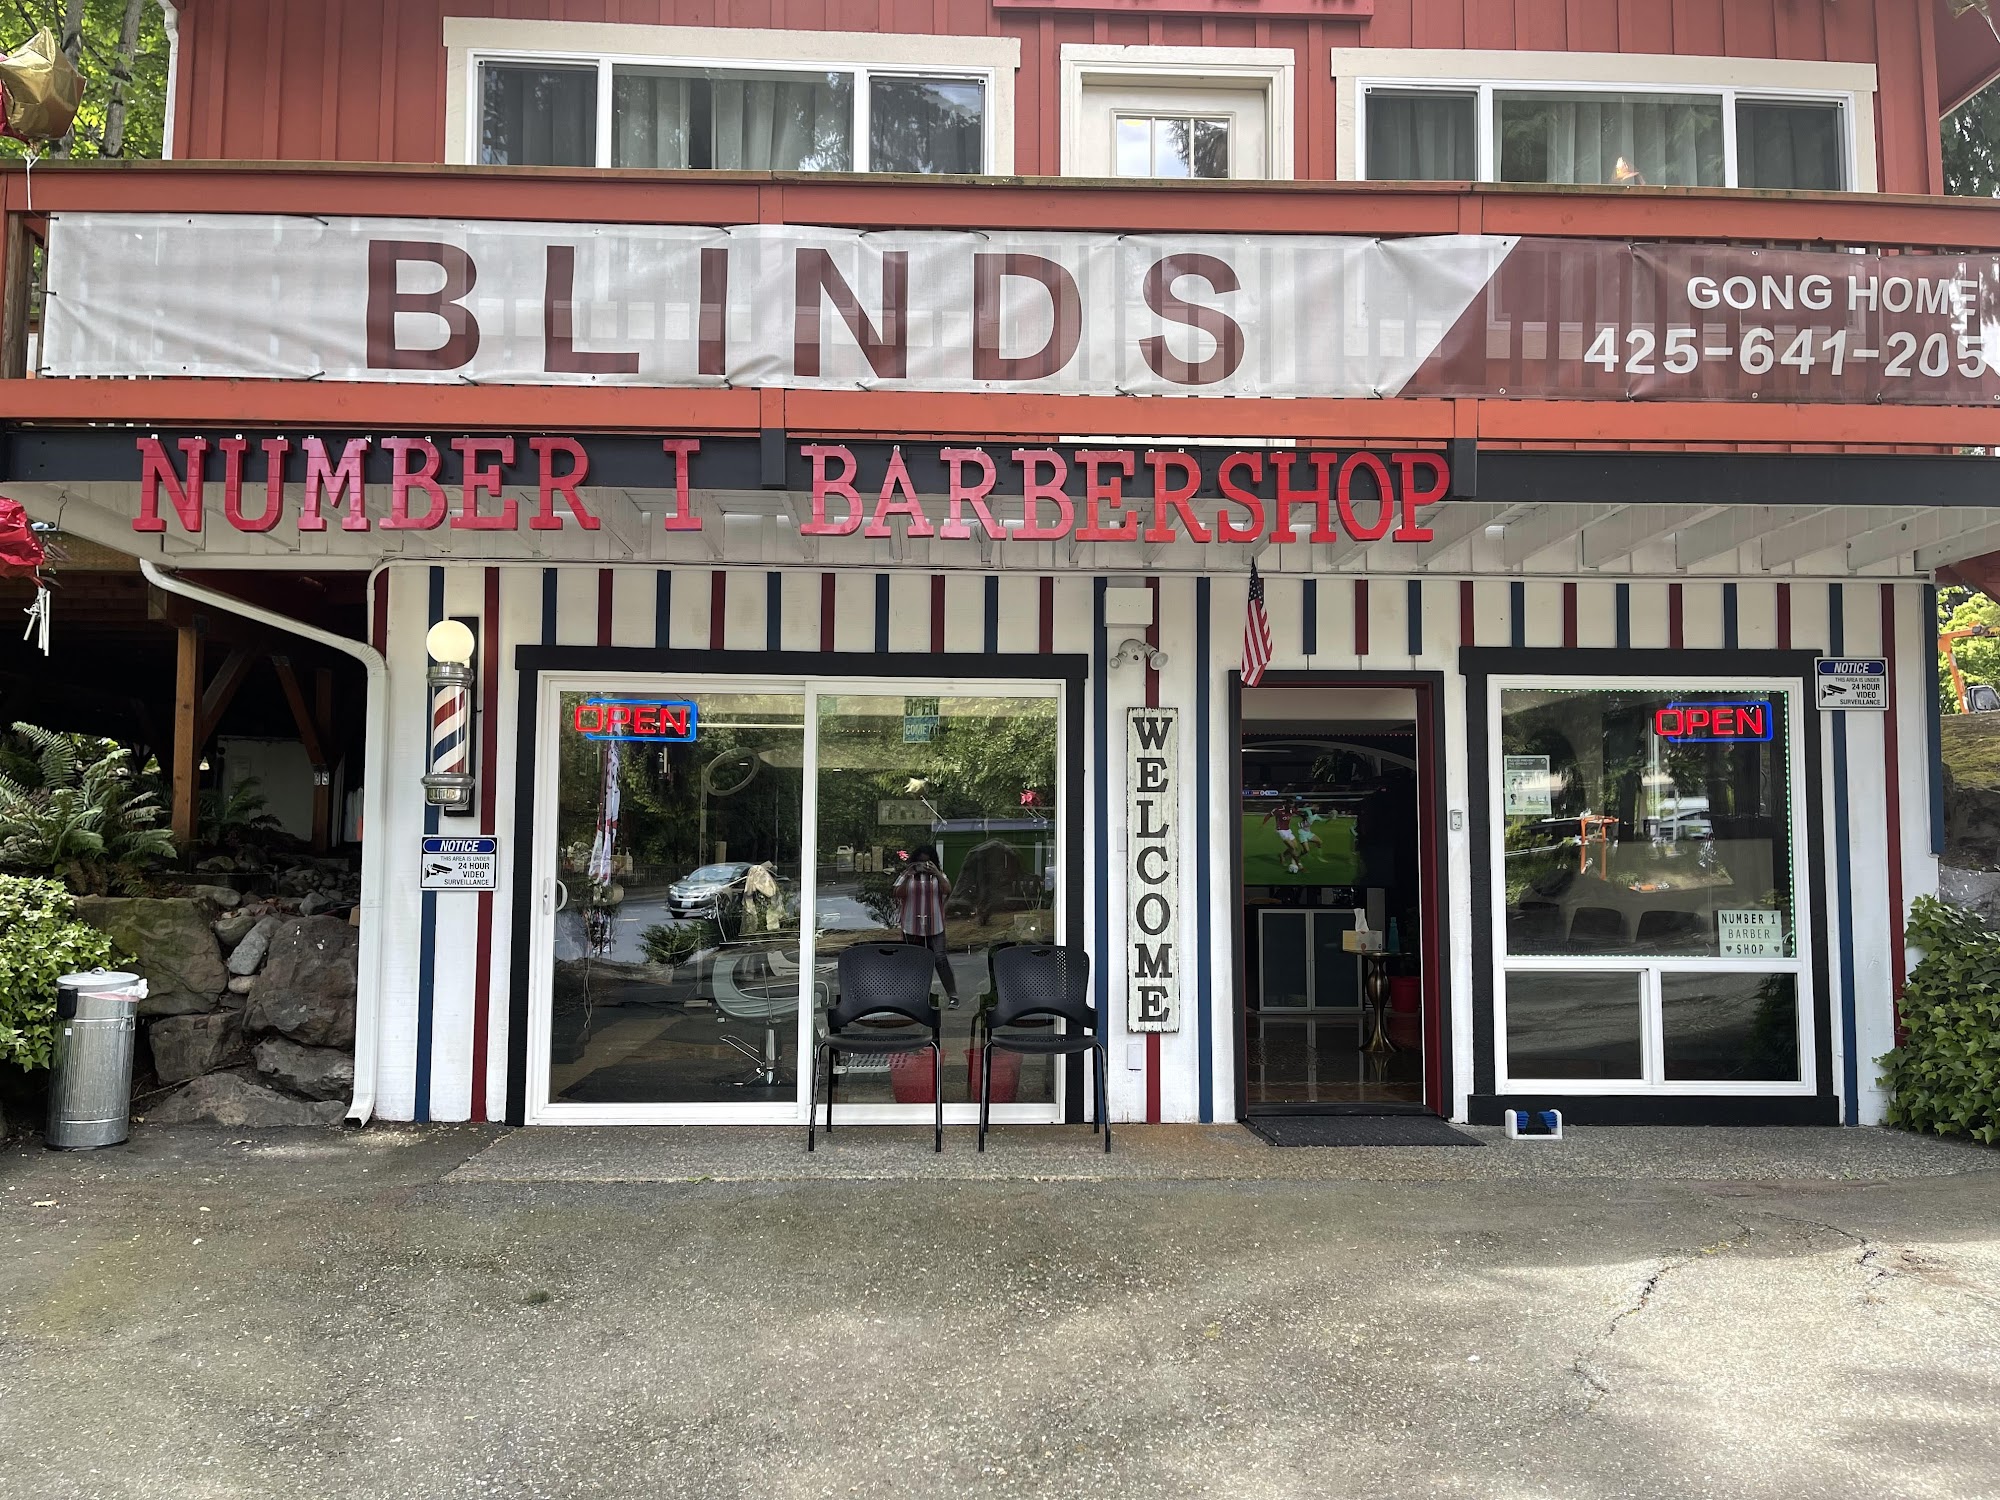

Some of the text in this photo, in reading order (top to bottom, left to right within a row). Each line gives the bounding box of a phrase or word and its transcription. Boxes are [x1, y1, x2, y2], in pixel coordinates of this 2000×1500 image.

[1687, 274, 1978, 316] GONG HOME
[366, 238, 1246, 385] BLINDS
[132, 437, 600, 532] NUMBER
[800, 444, 1450, 543] BARBERSHOP
[1834, 662, 1870, 673] NOTICE
[575, 705, 686, 735] OPEN
[1655, 708, 1763, 735] OPEN
[440, 840, 480, 852] NOTICE
[1133, 717, 1173, 1022] WELCOME
[1721, 913, 1776, 924] NUMBER 1
[1728, 929, 1770, 939] BARBER
[1736, 944, 1764, 954] SHOP
